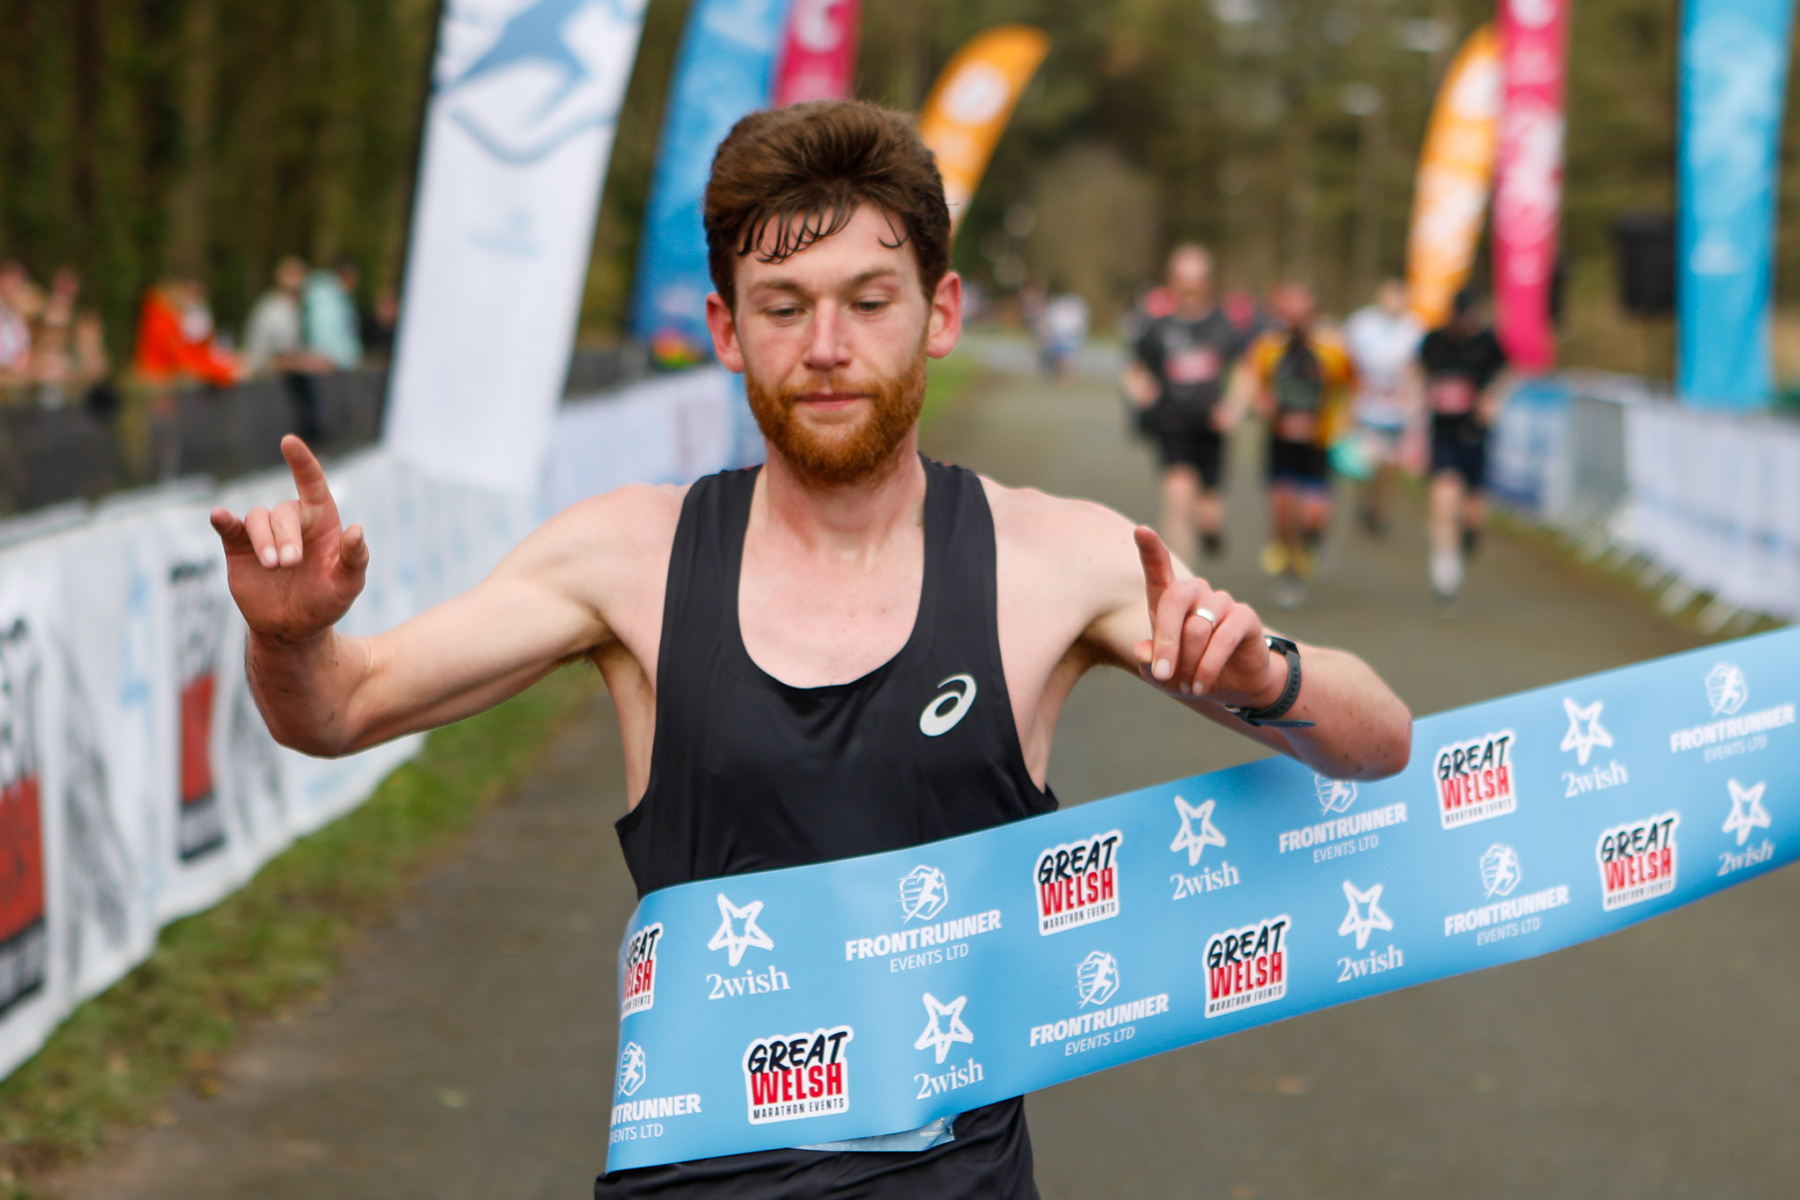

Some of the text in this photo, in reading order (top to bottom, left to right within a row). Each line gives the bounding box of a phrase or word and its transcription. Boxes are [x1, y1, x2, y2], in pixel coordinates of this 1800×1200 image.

[1670, 703, 1796, 754] FRONTRUNNER
[1704, 734, 1768, 763] EVENTS LTD
[1438, 736, 1510, 780] GREAT
[1441, 766, 1510, 811] WELSH
[1562, 761, 1628, 798] 2wish
[1279, 803, 1407, 853] FRONTRUNNER
[1313, 834, 1379, 863] EVENTS LTD
[1602, 818, 1674, 862] GREAT
[1038, 835, 1118, 885] GREAT
[1605, 847, 1671, 894] WELSH
[1717, 839, 1775, 877] 2wish
[1040, 867, 1114, 916] WELSH
[1170, 861, 1240, 900] 2wish
[1043, 902, 1116, 931] MARATHON EVENTS
[1444, 884, 1569, 937] FRONTRUNNER
[1477, 917, 1541, 946] EVENTS LTD
[845, 909, 1002, 961] FRONTRUNNER
[1208, 920, 1286, 970] GREAT
[890, 942, 969, 973] EVENTS LTD
[1210, 952, 1282, 1000] WELSH
[1337, 945, 1404, 983] 2wish
[706, 965, 790, 1000] 2wish
[1208, 985, 1283, 1014] MARATHON EVENTS
[1030, 993, 1169, 1047] FRONTRUNNER
[1065, 1026, 1136, 1056] EVENTS LTD
[748, 1031, 848, 1075] GREAT
[751, 1062, 842, 1106] WELSH
[914, 1058, 984, 1099] 2wish
[753, 1097, 844, 1119] MARATHON EVENTS
[640, 1123, 663, 1139] LTD
